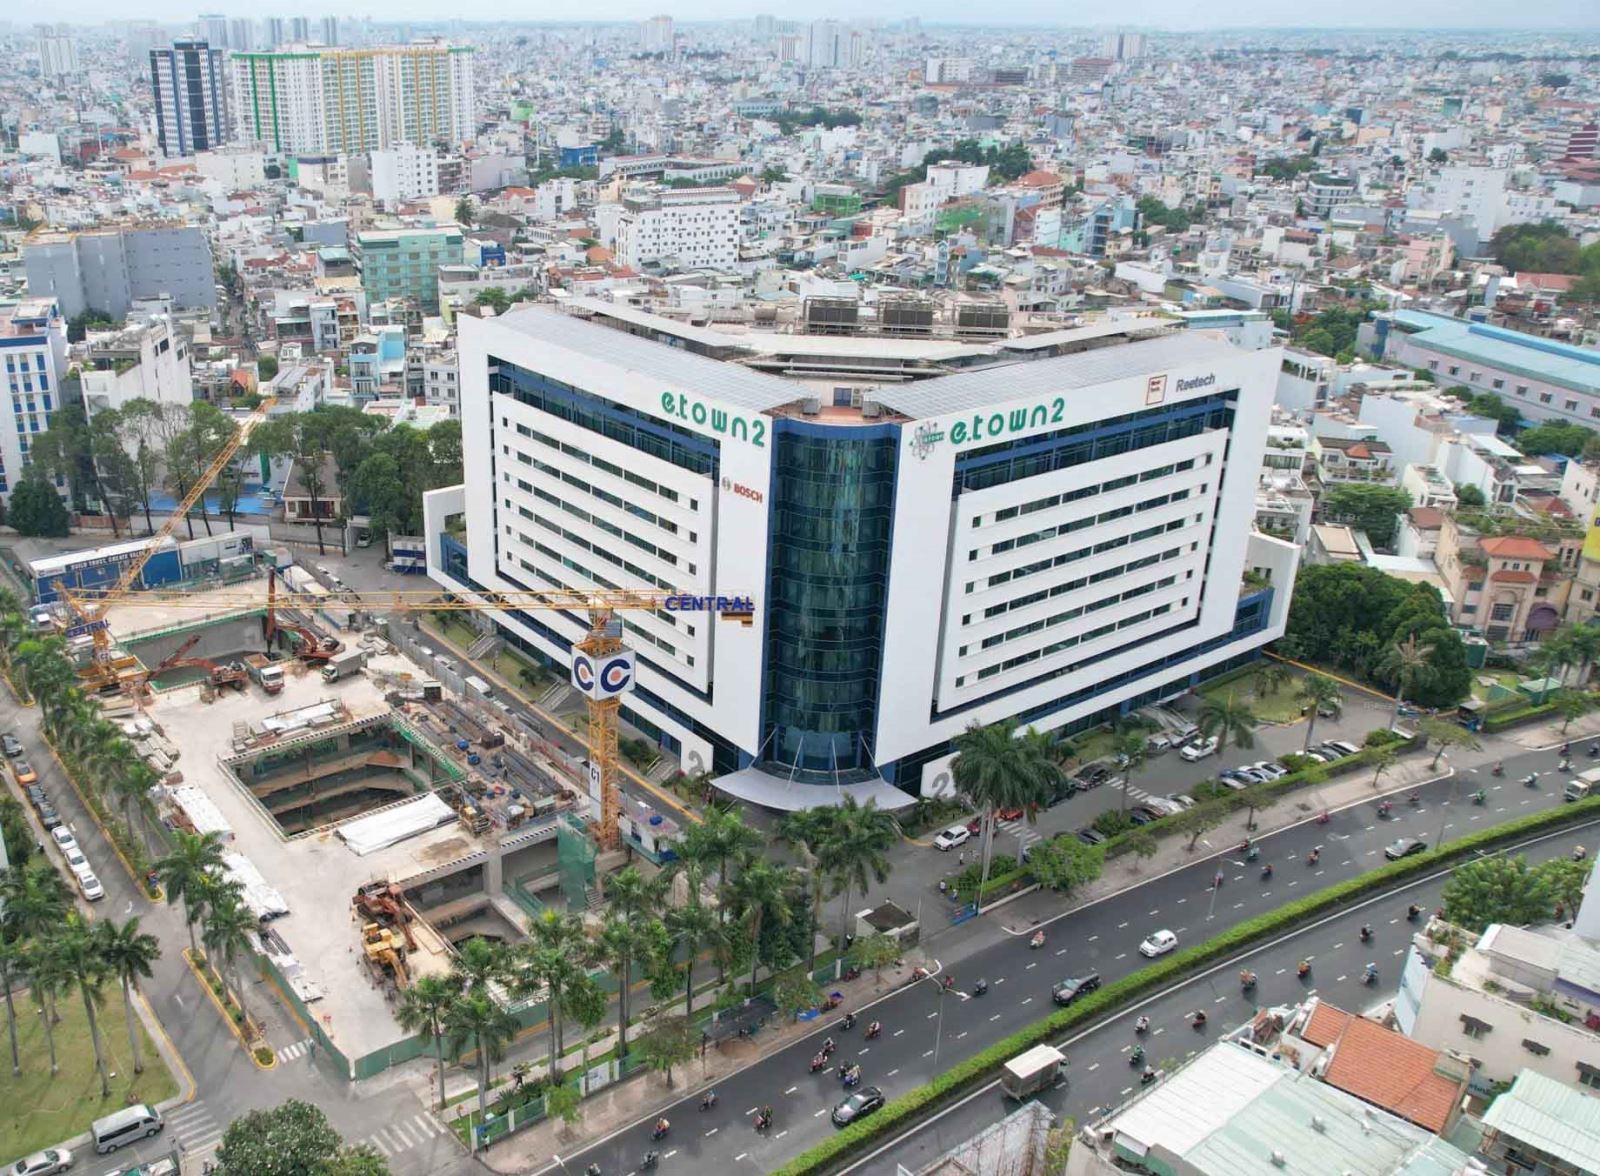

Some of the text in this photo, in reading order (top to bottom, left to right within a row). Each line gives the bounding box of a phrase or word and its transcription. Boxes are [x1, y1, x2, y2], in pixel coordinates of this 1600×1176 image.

[1175, 372, 1216, 393] Reetech
[661, 391, 766, 448] e.town2
[950, 397, 1065, 444] e.town2
[733, 483, 764, 504] BOSCH
[664, 594, 756, 612] CENTRAL
[590, 767, 600, 783] C1
[931, 771, 950, 802] 2
